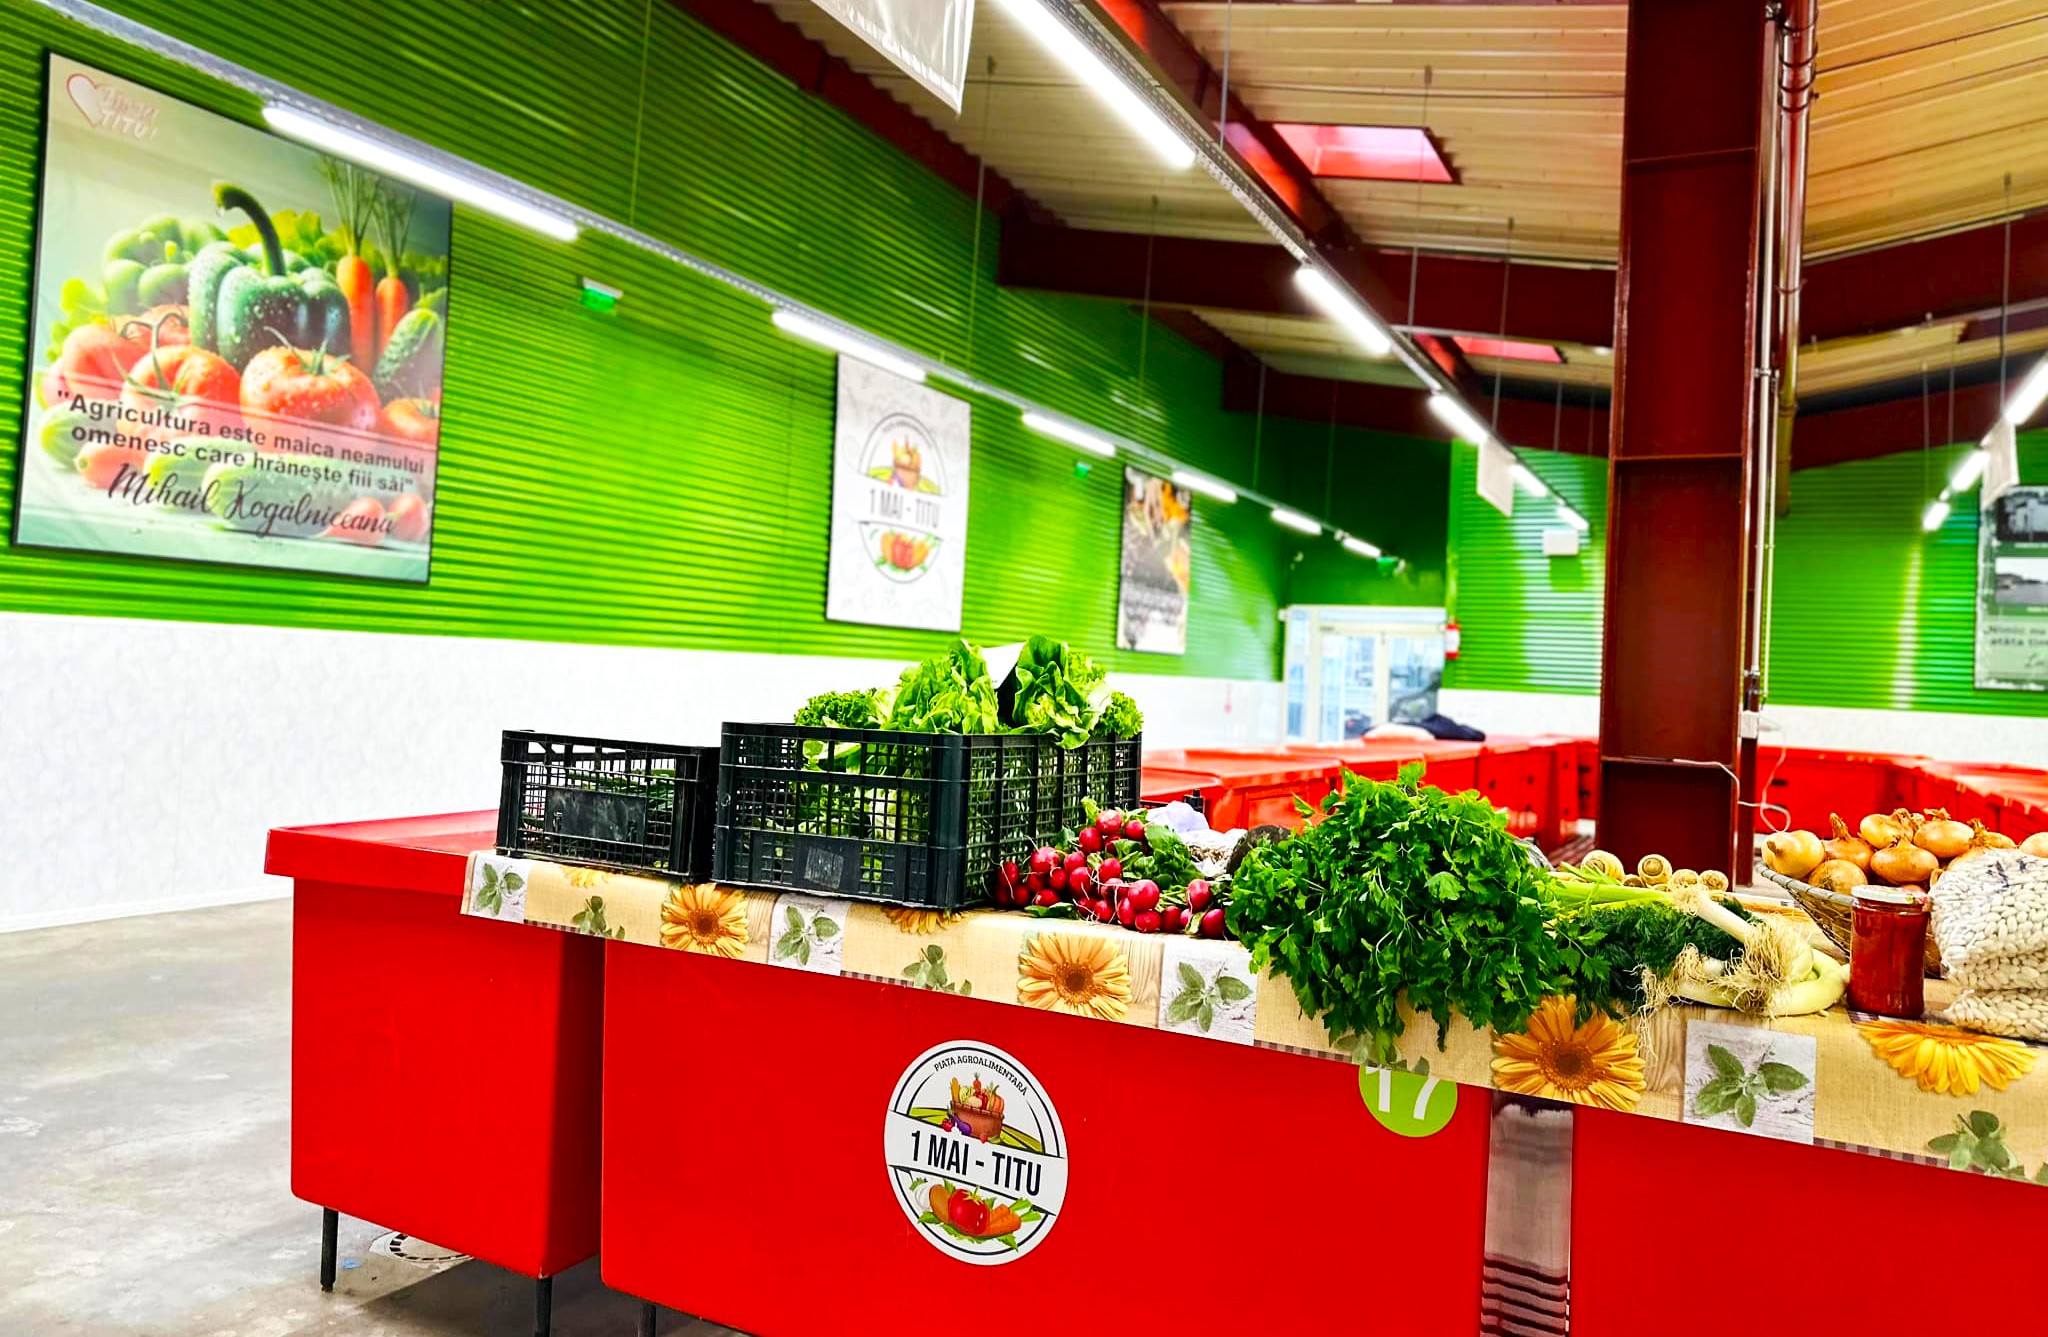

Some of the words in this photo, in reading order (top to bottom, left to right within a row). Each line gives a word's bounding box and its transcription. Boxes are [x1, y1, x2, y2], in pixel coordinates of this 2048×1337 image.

[57, 389, 210, 436] "Agricultura
[219, 424, 266, 446] este
[273, 435, 334, 458] maica
[341, 448, 424, 474] neamului
[71, 426, 186, 457] omenesc
[195, 447, 245, 466] care
[349, 469, 372, 489] fiii
[108, 462, 221, 514] Mihail
[880, 490, 904, 520] MAI
[915, 498, 940, 529] TITU
[1365, 1064, 1440, 1120] 17
[911, 1130, 921, 1162] 1
[928, 1134, 969, 1176] MAI
[975, 1159, 985, 1167] -
[991, 1151, 1042, 1196] TITU
